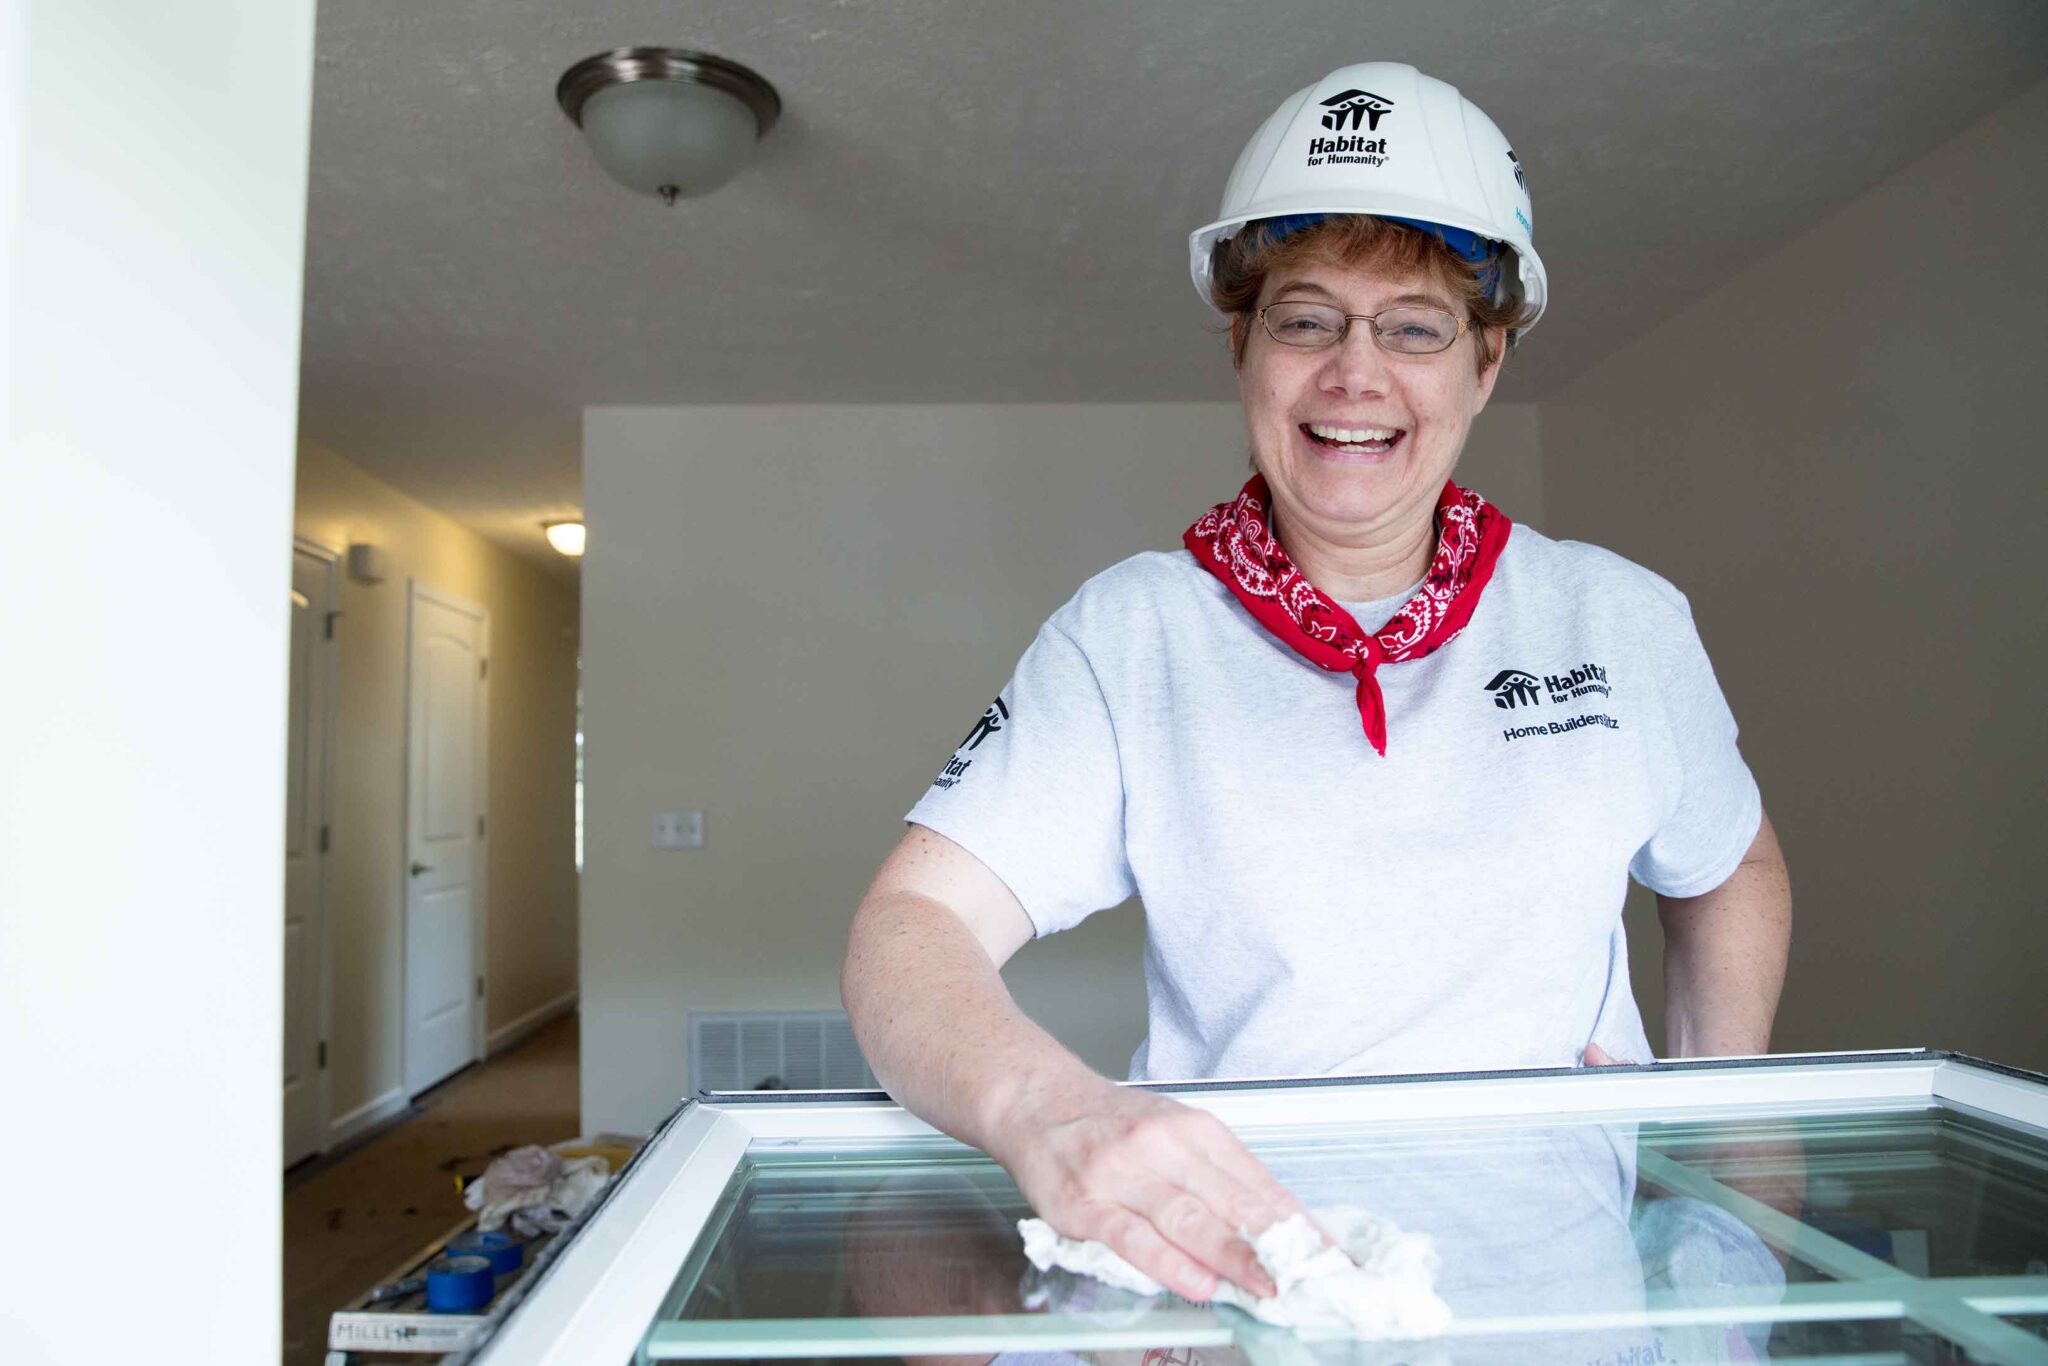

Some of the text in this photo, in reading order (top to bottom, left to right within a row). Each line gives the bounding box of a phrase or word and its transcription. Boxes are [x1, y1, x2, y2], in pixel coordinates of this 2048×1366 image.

[1308, 135, 1387, 154] Habitat
[1307, 156, 1324, 167] for
[1551, 694, 1568, 704] for
